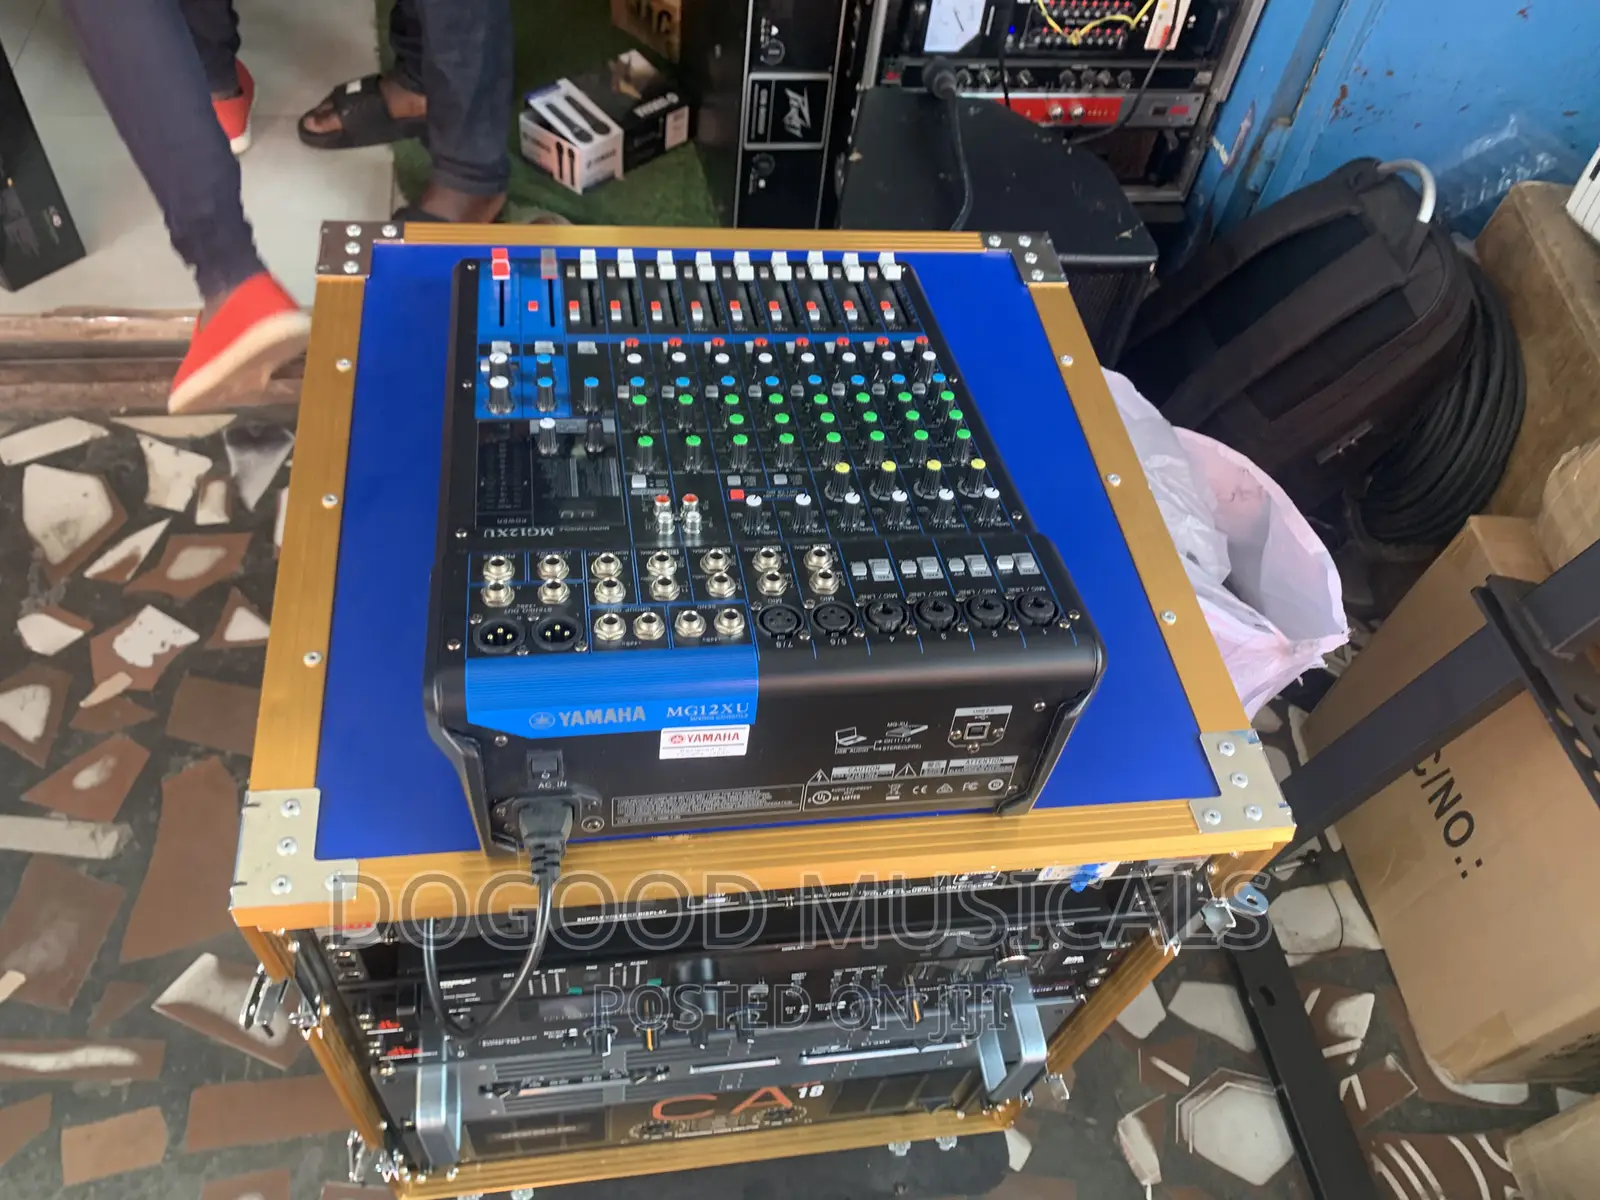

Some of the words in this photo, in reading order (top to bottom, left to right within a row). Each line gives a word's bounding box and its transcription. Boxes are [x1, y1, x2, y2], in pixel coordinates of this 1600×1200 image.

[483, 526, 554, 538] MG12XU
[559, 706, 646, 727] YAMAHA
[666, 702, 749, 718] MG12XU
[687, 732, 740, 743] YAMAHA
